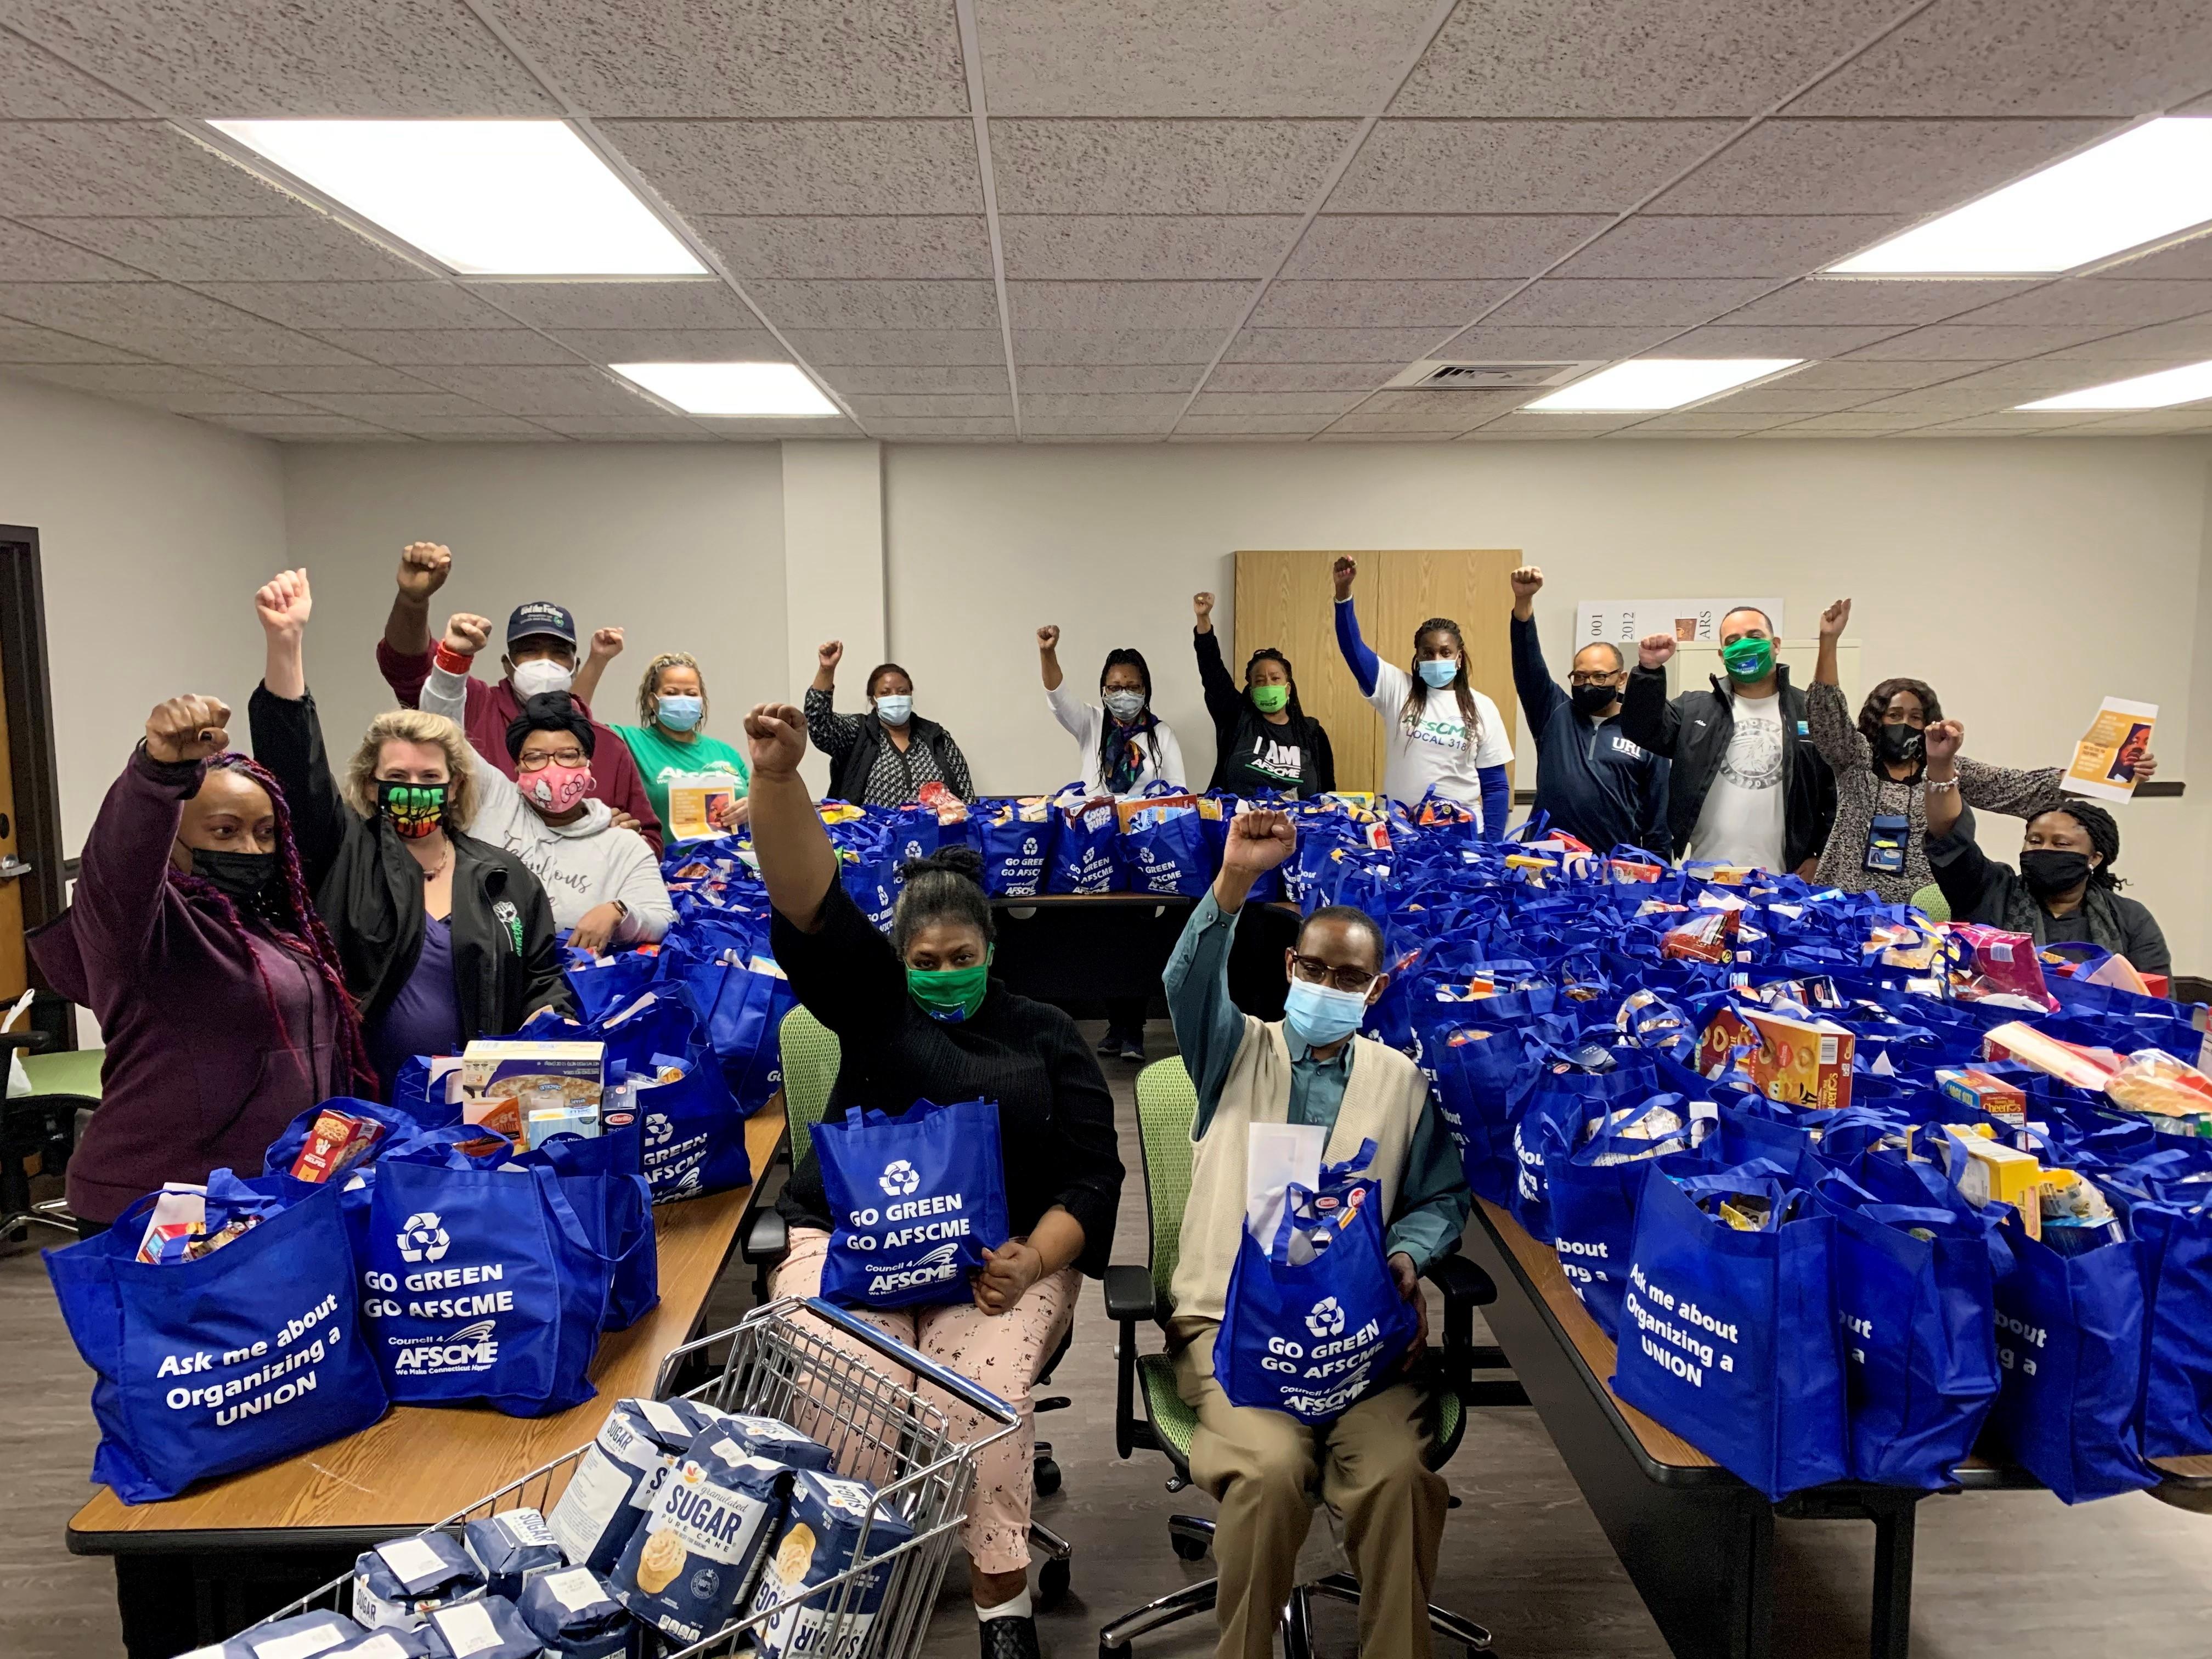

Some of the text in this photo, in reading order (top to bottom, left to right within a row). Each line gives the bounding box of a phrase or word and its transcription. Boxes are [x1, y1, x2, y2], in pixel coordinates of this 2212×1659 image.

[1622, 612, 1634, 640] 2012
[1253, 736, 1301, 766] I AM
[1406, 730, 1444, 746] LOCAL
[1613, 737, 1641, 757] URI
[1251, 758, 1301, 778] AFSCME
[388, 787, 444, 815] ONE
[1084, 805, 1111, 822] Cocoa
[1070, 856, 1110, 874] GO GREEN
[1081, 866, 1114, 884] AFSCME
[1145, 860, 1176, 873] GREEN
[1827, 1073, 1838, 1109] eerios
[1983, 1102, 2022, 1113] Cheerios
[303, 1154, 326, 1169] HELPER
[644, 1132, 708, 1165] GREEN
[850, 1193, 962, 1227] GO GREEN
[847, 1218, 970, 1251] GO AFSCME
[1555, 1237, 1609, 1258] bout
[364, 1264, 503, 1293] GO GREEN
[865, 1262, 905, 1272] Council
[868, 1263, 957, 1291] AFSCME
[1595, 1271, 1609, 1282] a
[364, 1290, 514, 1318] GO AFSCME
[1649, 1285, 1674, 1311] me
[1678, 1302, 1738, 1344] about
[157, 1294, 338, 1378] Ask me about
[1268, 1318, 1380, 1359] GO GREEN
[1627, 1293, 1713, 1368] Organizing
[1720, 1355, 1734, 1373] a
[1839, 1310, 1872, 1339] out
[1994, 1308, 2047, 1347] bout
[388, 1336, 433, 1345] Council
[166, 1327, 341, 1409] Organizing a
[395, 1341, 499, 1369] AFSCME
[428, 1364, 471, 1374] Connecticut
[1261, 1341, 1384, 1379] GO AFSCME
[1641, 1335, 1702, 1387] UNION
[2023, 1358, 2036, 1376] a
[216, 1370, 317, 1426] UNION
[1280, 1386, 1322, 1396] Council
[607, 1419, 633, 1451] SUGAR
[701, 1486, 749, 1513] granulated
[832, 1485, 866, 1510] SUGA
[519, 1513, 555, 1543] SUGAR
[666, 1485, 742, 1544] SUGAR
[661, 1514, 730, 1553] PURE CANE
[357, 1588, 376, 1622] SUGAR
[756, 1582, 785, 1630] SUG
